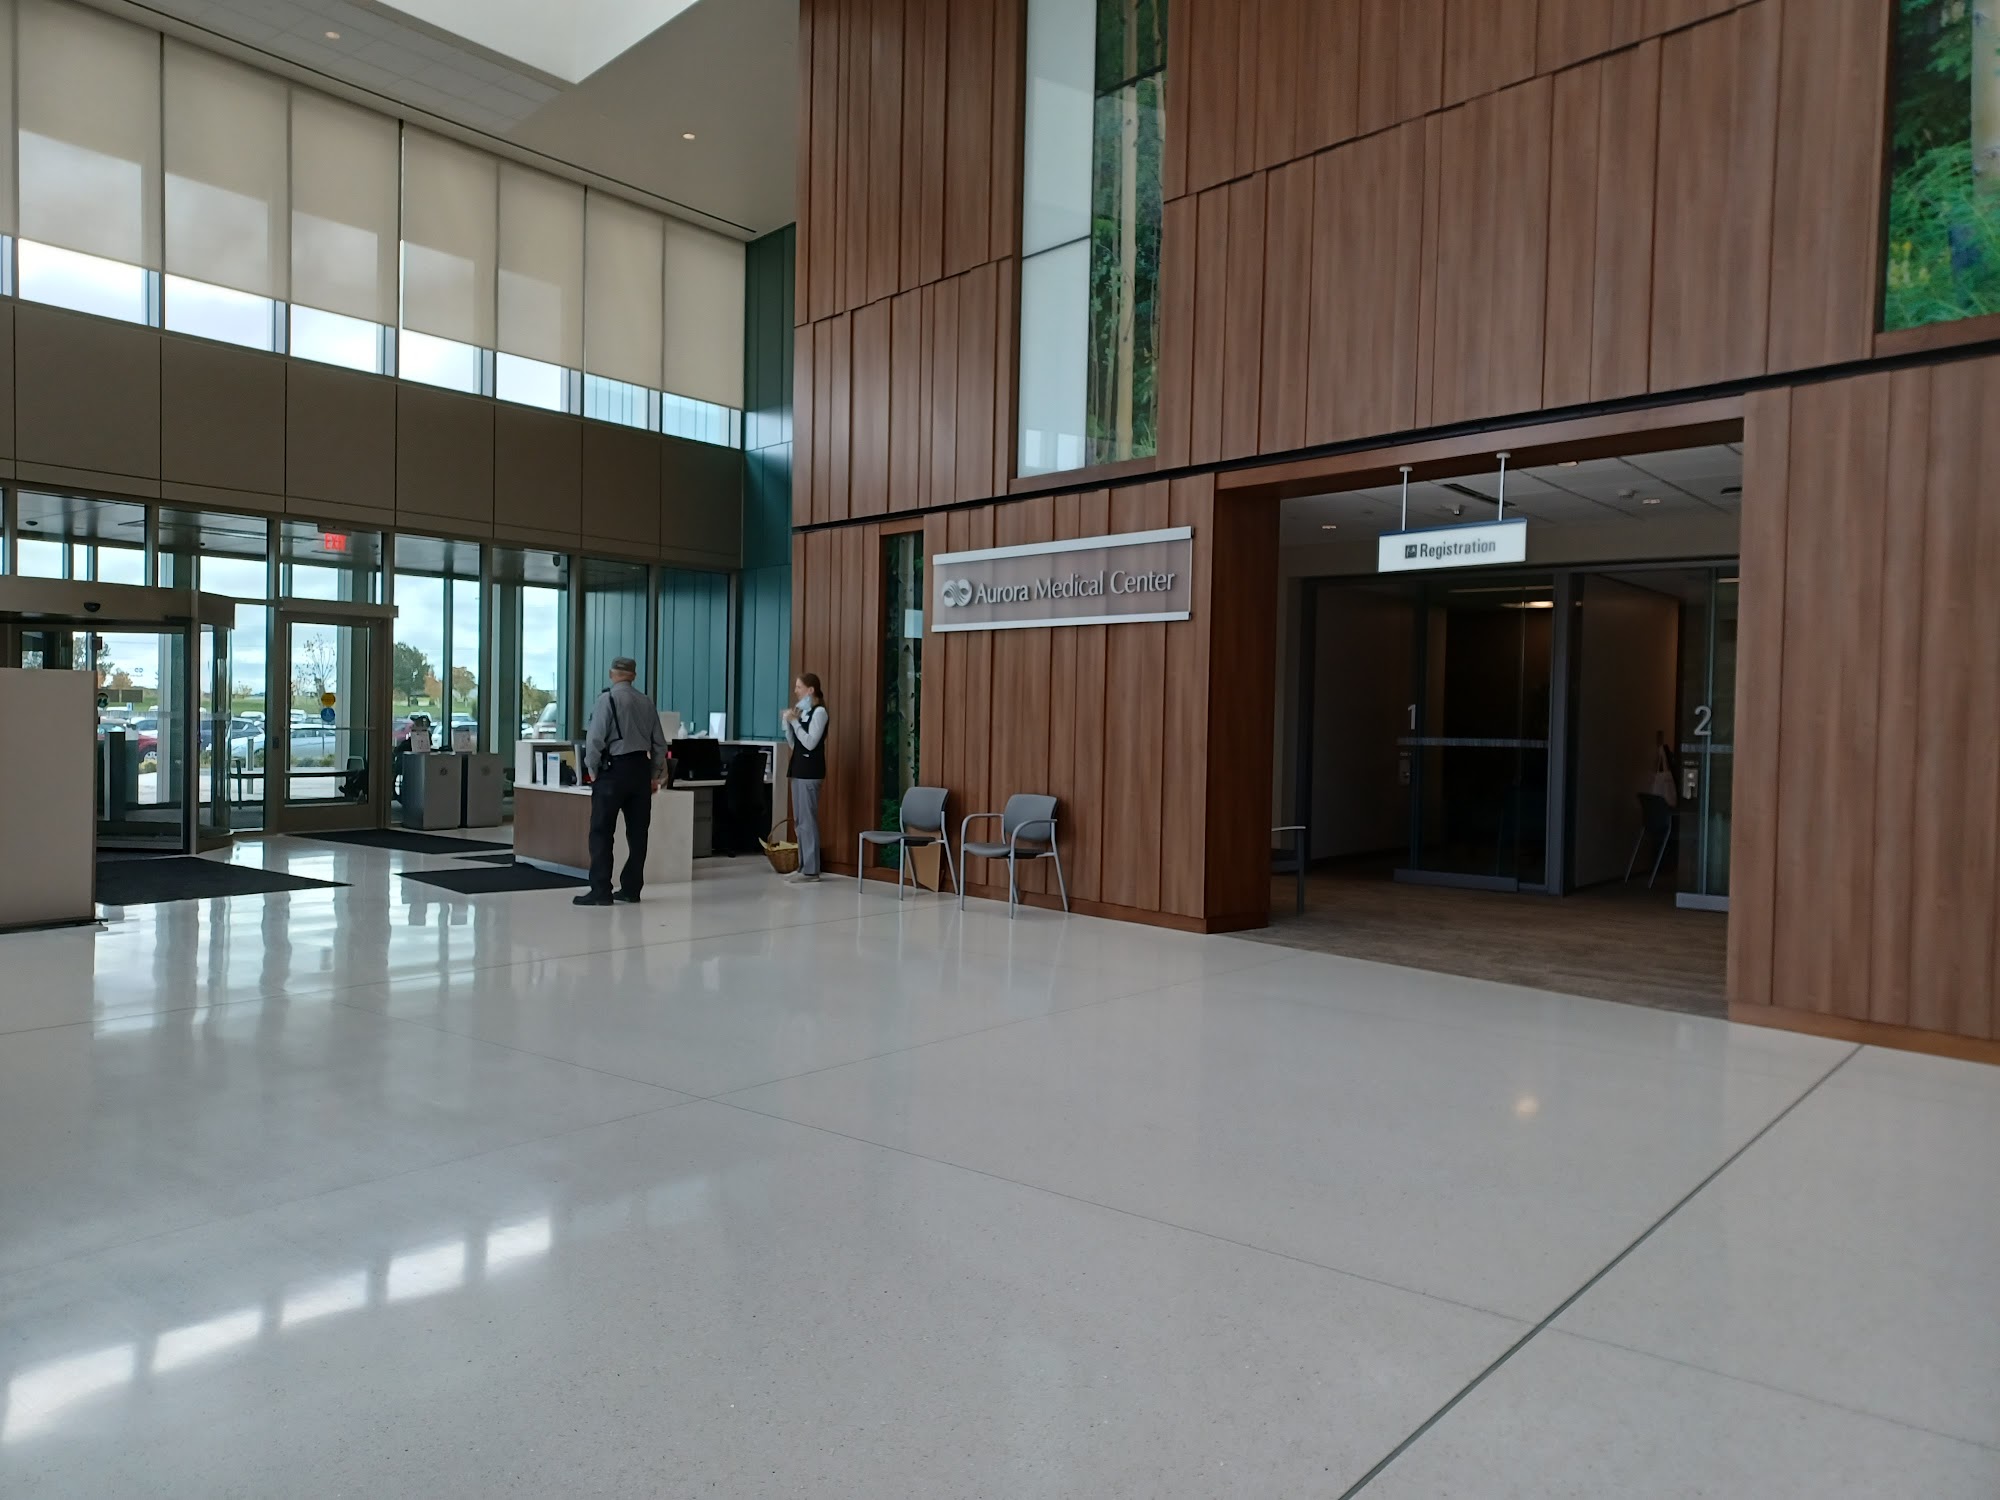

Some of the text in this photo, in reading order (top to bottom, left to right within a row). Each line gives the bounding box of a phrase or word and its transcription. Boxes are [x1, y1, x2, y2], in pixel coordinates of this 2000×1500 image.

[1420, 538, 1496, 560] Registration
[975, 570, 1176, 604] Aurora Medical Center
[1407, 704, 1416, 730] 1
[1694, 705, 1712, 736] 2
